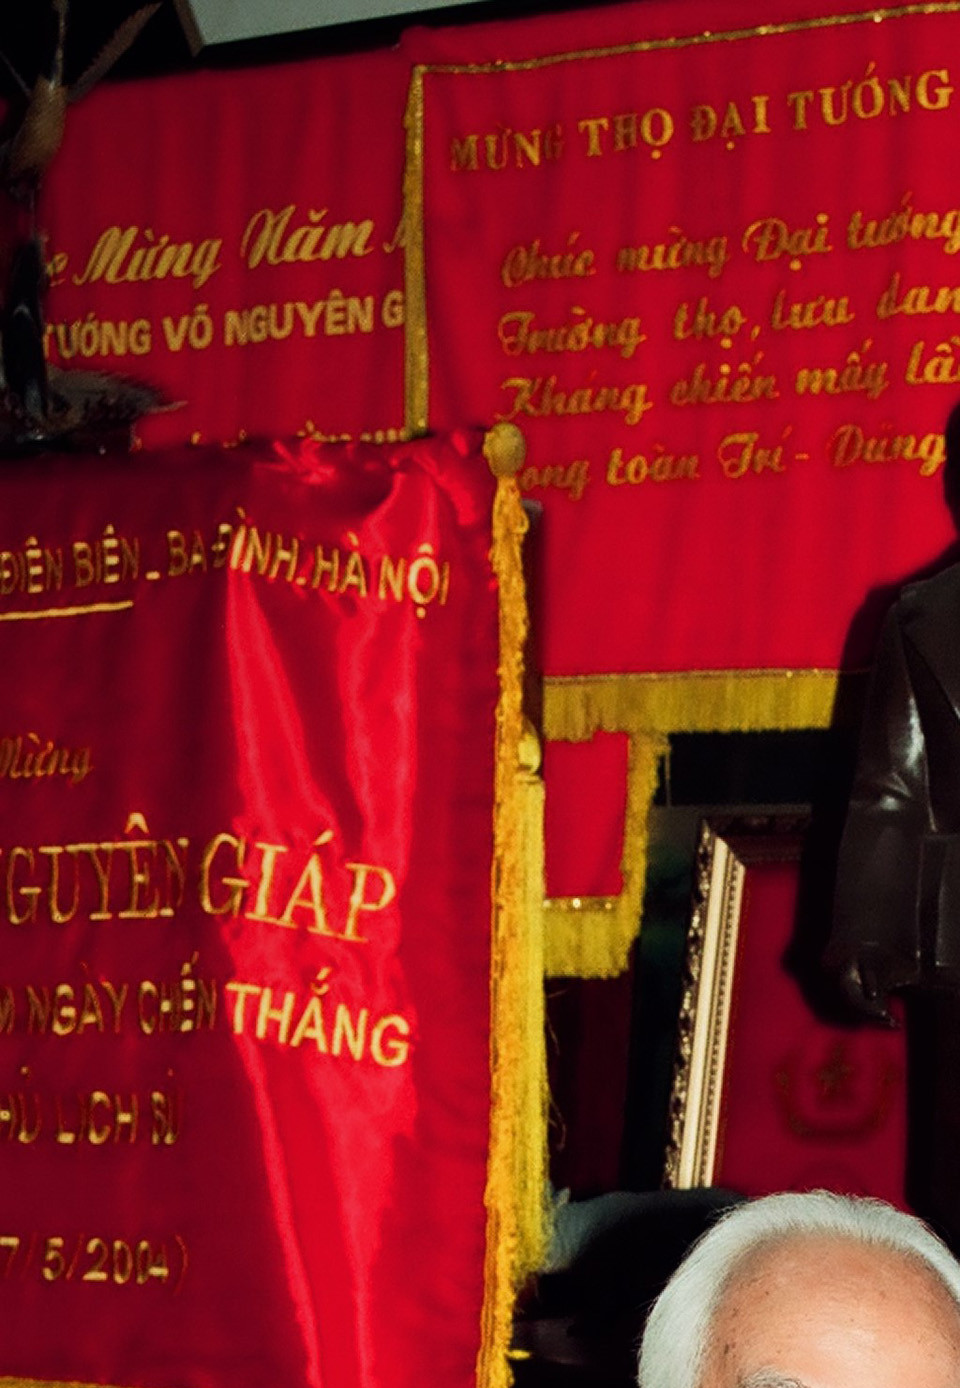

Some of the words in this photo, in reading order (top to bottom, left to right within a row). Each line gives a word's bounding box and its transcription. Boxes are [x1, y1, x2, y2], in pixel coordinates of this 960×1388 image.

[578, 108, 674, 159] THỌ
[691, 95, 772, 151] ĐẠI
[787, 62, 952, 128] TƯỚNG
[73, 226, 222, 289] Mừng
[241, 204, 374, 269] Năm
[502, 232, 597, 289] Chúc
[617, 225, 729, 279] mừng
[742, 213, 832, 271] Đại
[224, 289, 374, 346] NGUYÊN
[518, 459, 591, 500] ong
[378, 543, 450, 619] NỘI
[0, 811, 189, 925] GUYÊN
[200, 830, 397, 943] GIÁP
[225, 967, 412, 1067] THẮNG
